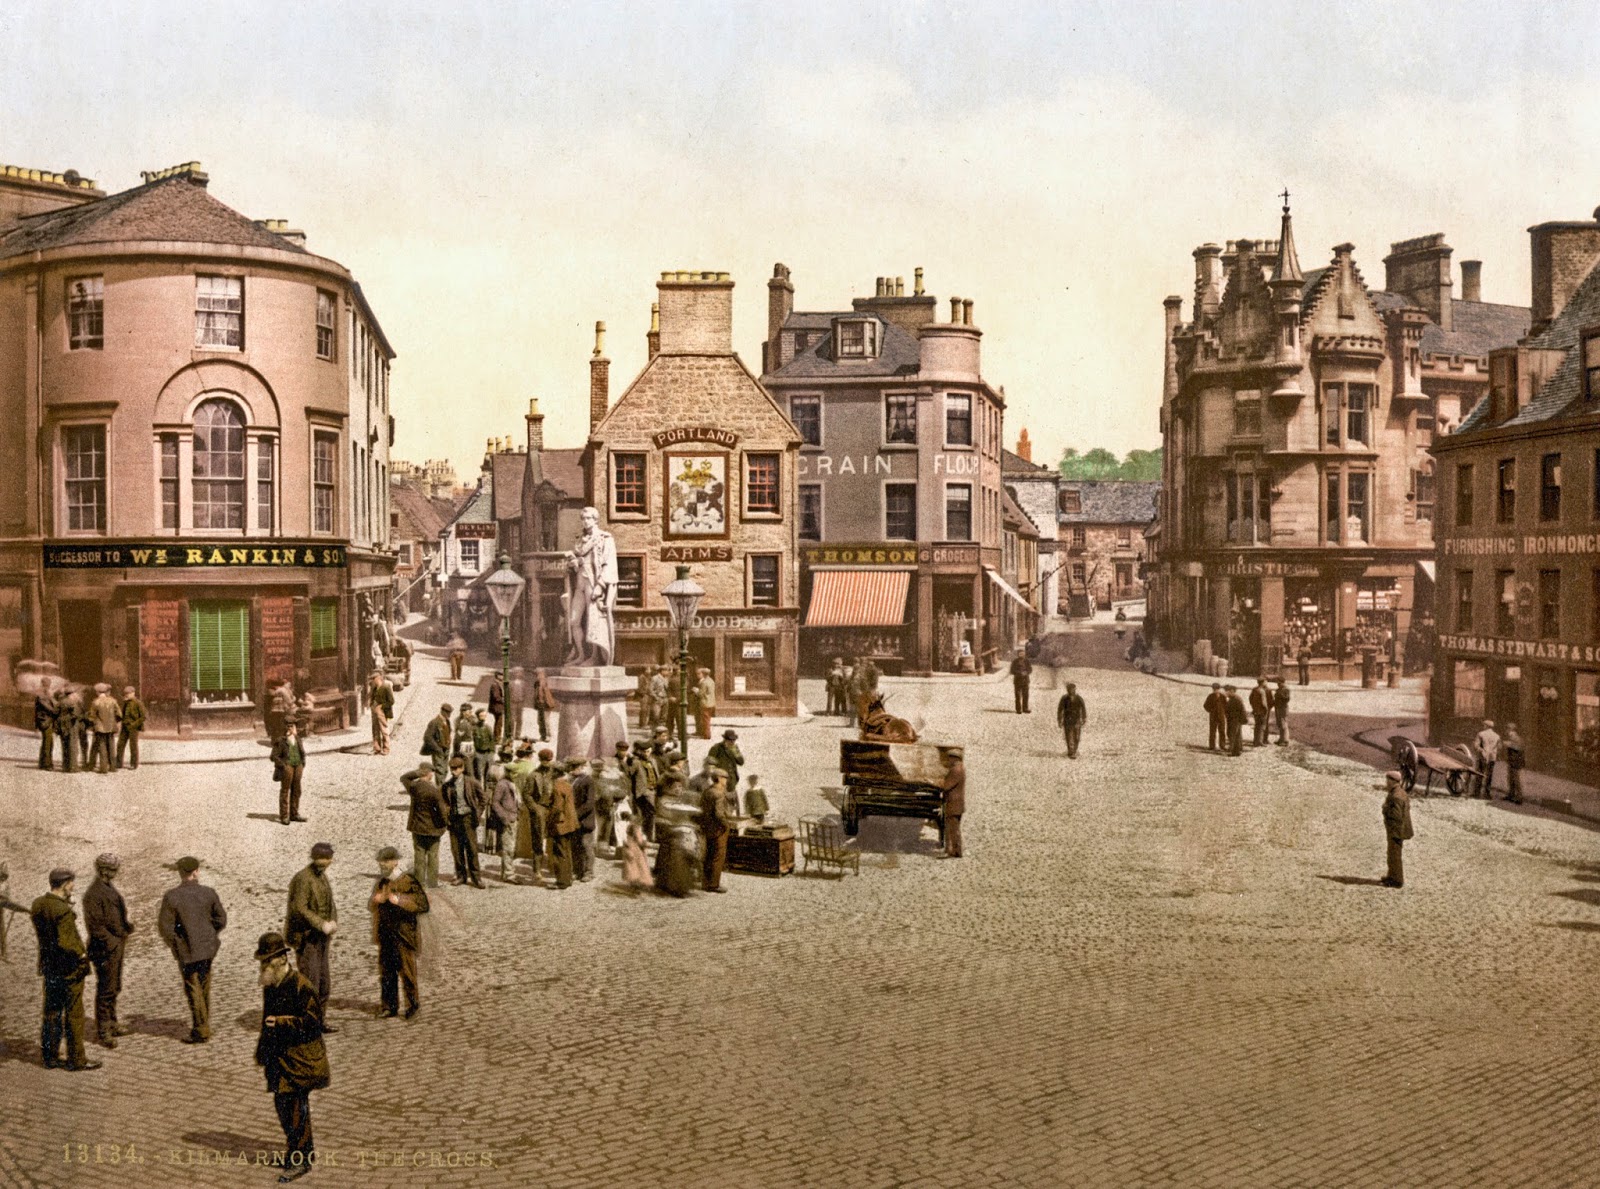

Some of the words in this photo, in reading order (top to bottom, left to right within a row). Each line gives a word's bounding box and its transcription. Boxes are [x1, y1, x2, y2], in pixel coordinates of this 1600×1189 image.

[657, 428, 735, 445] PORTLAND
[666, 547, 728, 561] ARMS
[1445, 538, 1516, 554] FURNISHING
[49, 551, 101, 563] SUCCESSOR
[105, 551, 120, 563] TO
[186, 549, 297, 565] RANKIN
[304, 549, 316, 563] &
[806, 550, 917, 563] THOMSON
[1439, 635, 1494, 653] THOMAS
[1498, 640, 1568, 659] STEWART
[1571, 646, 1581, 661] &
